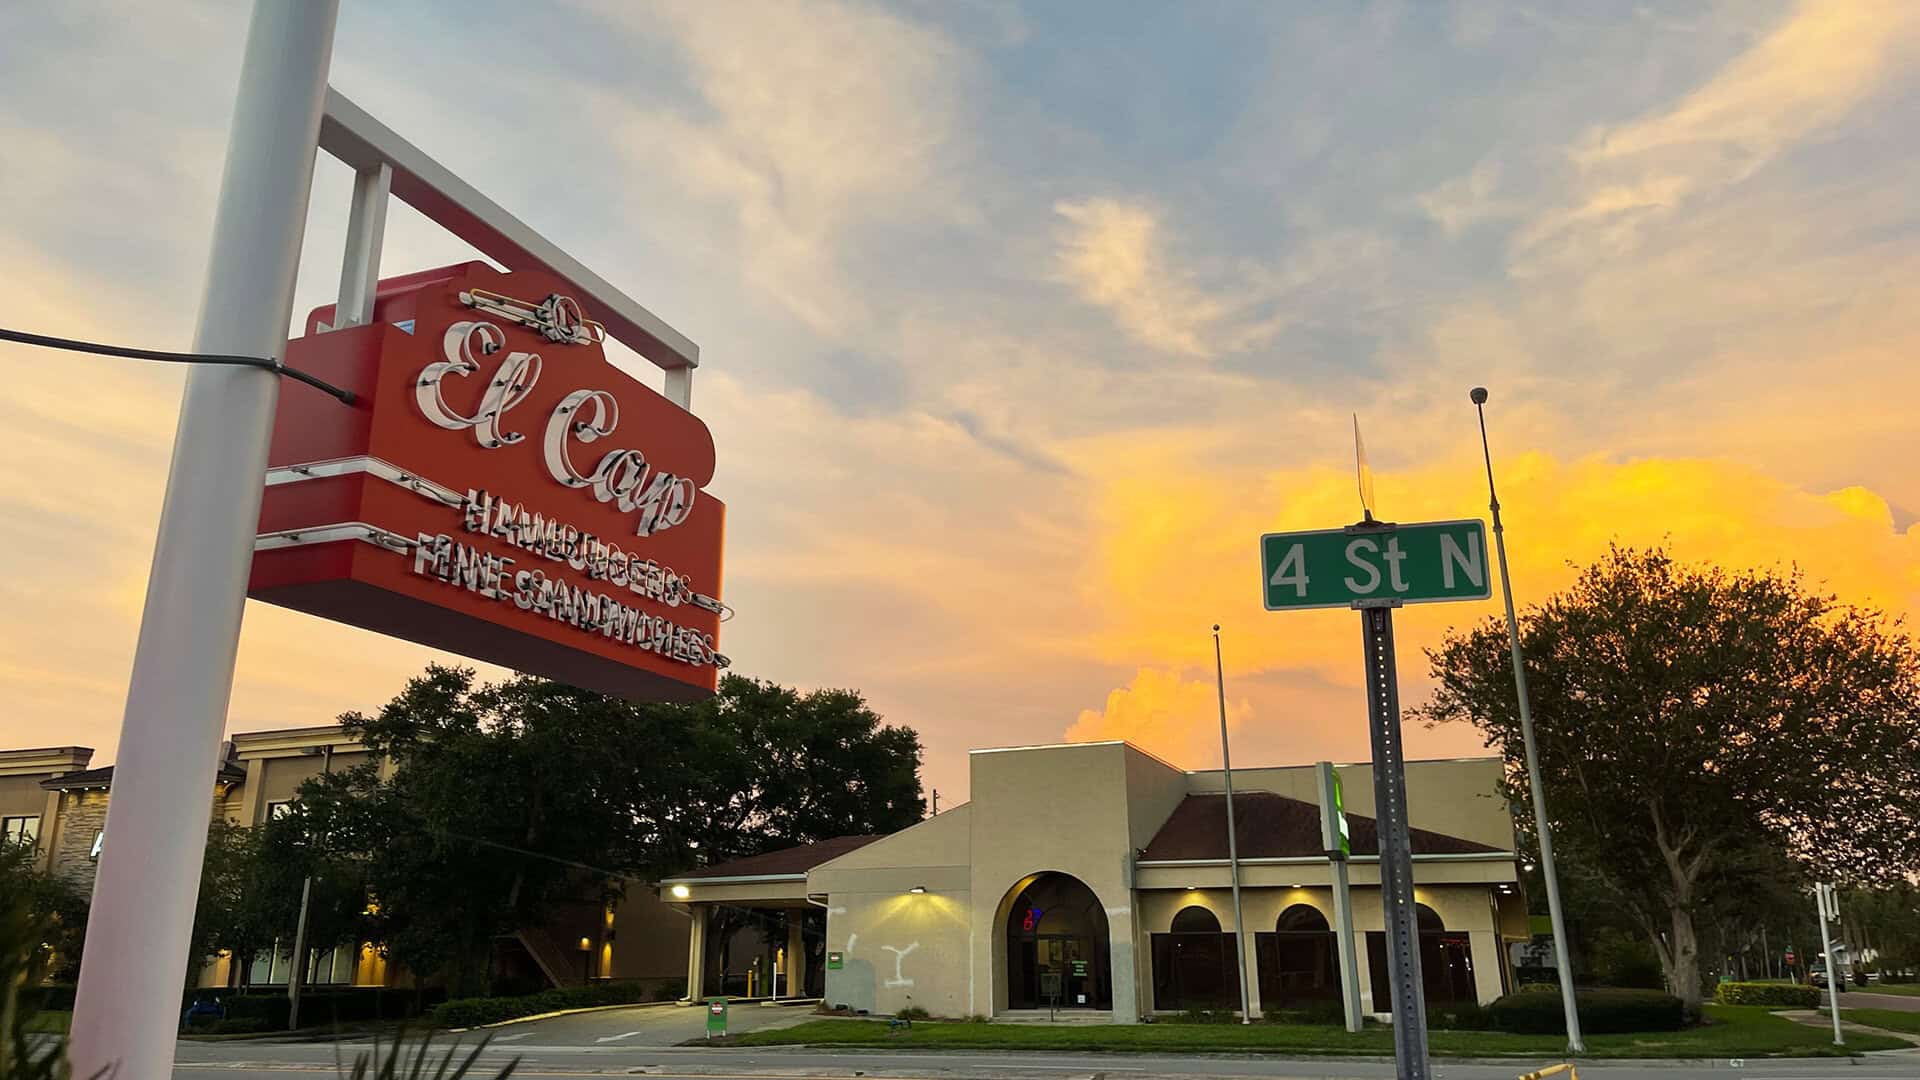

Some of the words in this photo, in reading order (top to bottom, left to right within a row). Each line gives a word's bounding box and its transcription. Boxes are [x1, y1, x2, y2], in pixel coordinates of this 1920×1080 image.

[416, 321, 542, 449] El
[544, 389, 695, 537] Cap
[414, 532, 516, 600] FINE
[513, 569, 714, 667] SANDWICHES
[465, 488, 692, 607] HAMBURGERS
[1270, 543, 1310, 597] 4
[1344, 536, 1409, 594] St
[1440, 531, 1483, 589] N
